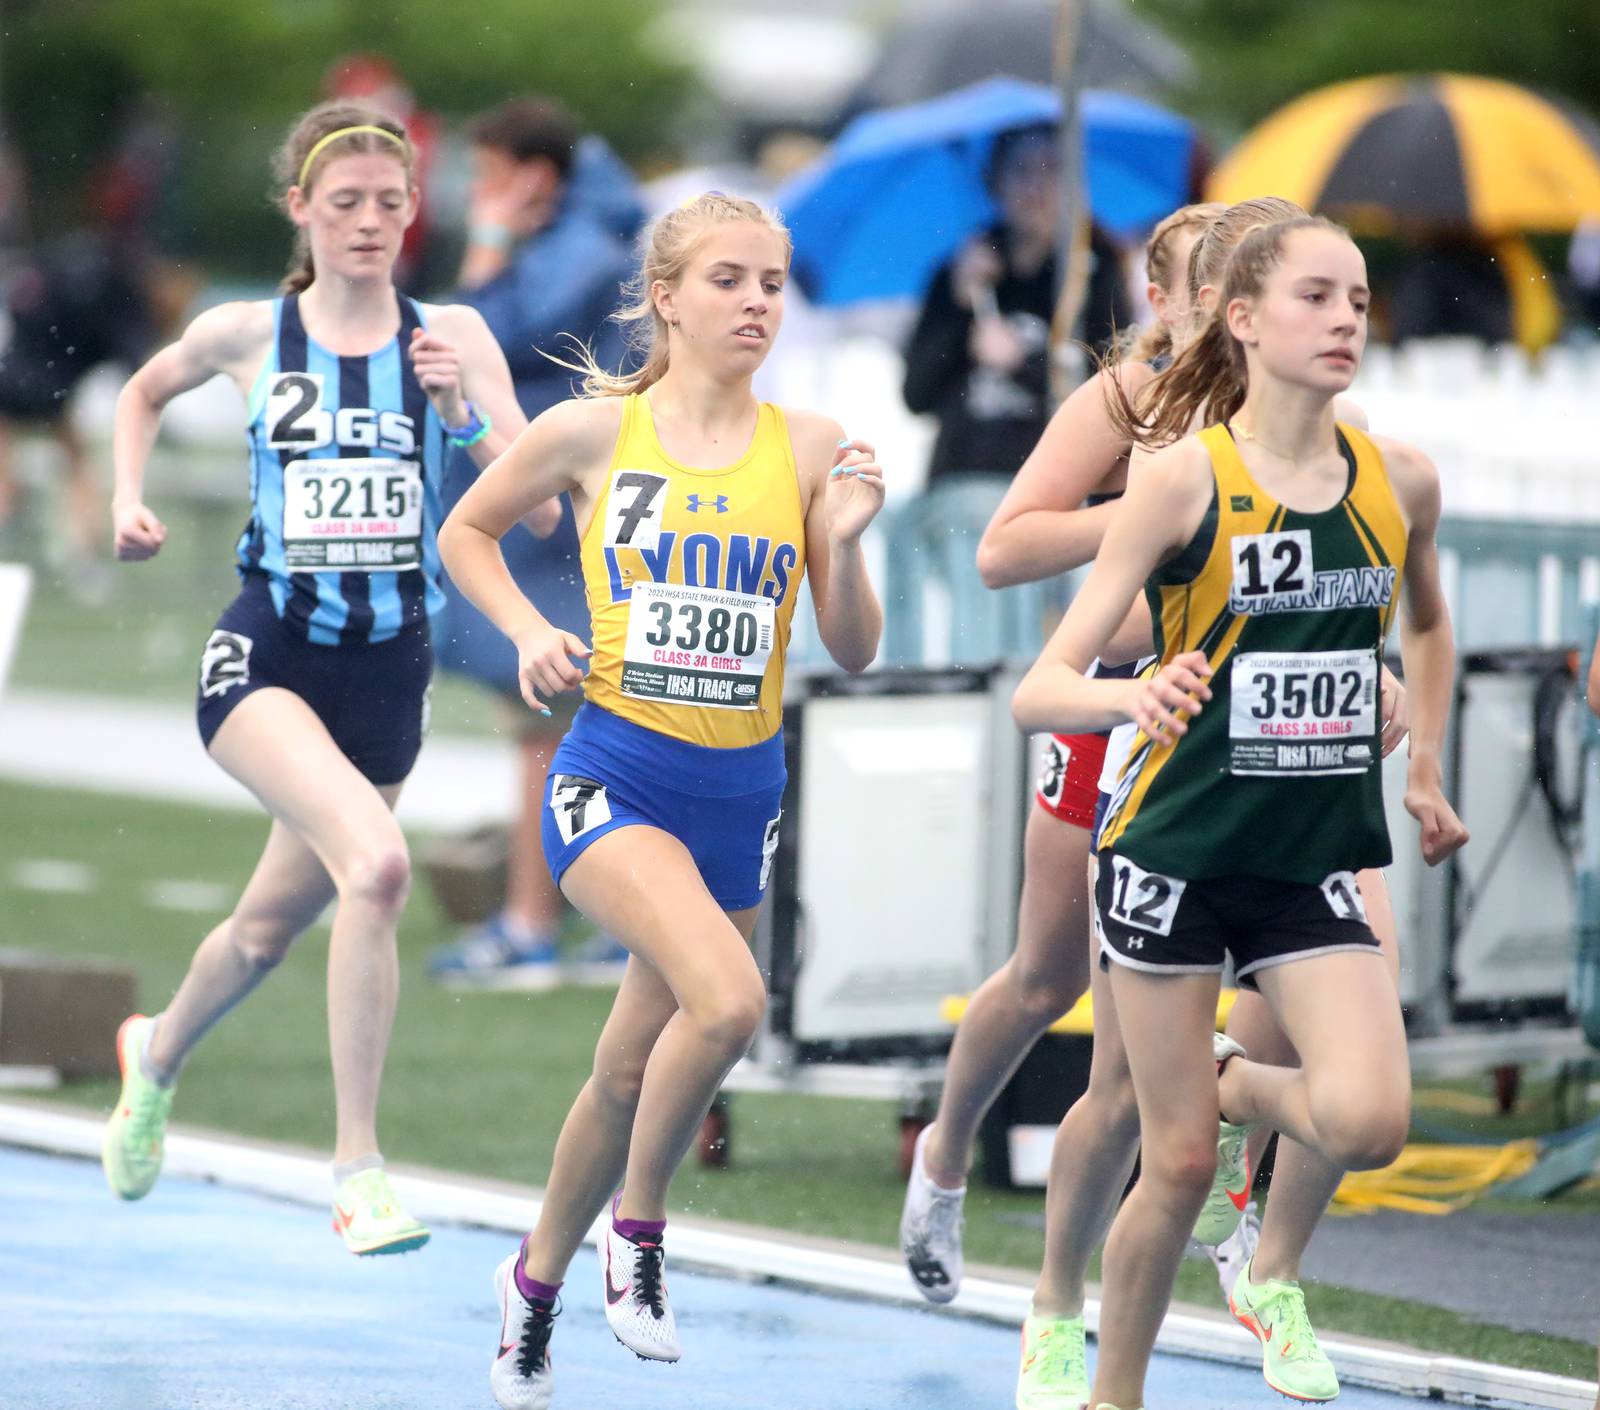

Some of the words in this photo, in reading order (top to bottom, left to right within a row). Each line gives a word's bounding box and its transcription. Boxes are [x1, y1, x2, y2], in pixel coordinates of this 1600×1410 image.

[272, 376, 319, 442] 2
[304, 477, 406, 518] 3215
[615, 472, 667, 544] 7
[1238, 540, 1303, 596] 12
[648, 588, 665, 598] 2022
[665, 591, 680, 599] IHSA
[681, 592, 699, 601] STATE
[700, 594, 719, 604] TRACK
[725, 597, 741, 606] FIELD
[741, 600, 757, 609] MEET
[646, 601, 758, 657] 3380
[206, 635, 245, 689] 2
[654, 649, 691, 666] CLASS
[693, 656, 708, 668] 3A
[711, 656, 742, 671] GIRLS
[666, 674, 695, 697] IHSA
[697, 677, 734, 701] TRACK
[1251, 670, 1363, 719] 3502
[1260, 722, 1300, 736] CLASS
[1303, 722, 1318, 735] 3A
[1322, 720, 1353, 734] GIRLS
[1277, 745, 1307, 767] IHSA
[1308, 744, 1346, 767] TRACK
[555, 775, 606, 836] 7
[1112, 866, 1171, 929] 12
[1330, 879, 1361, 920] 1
